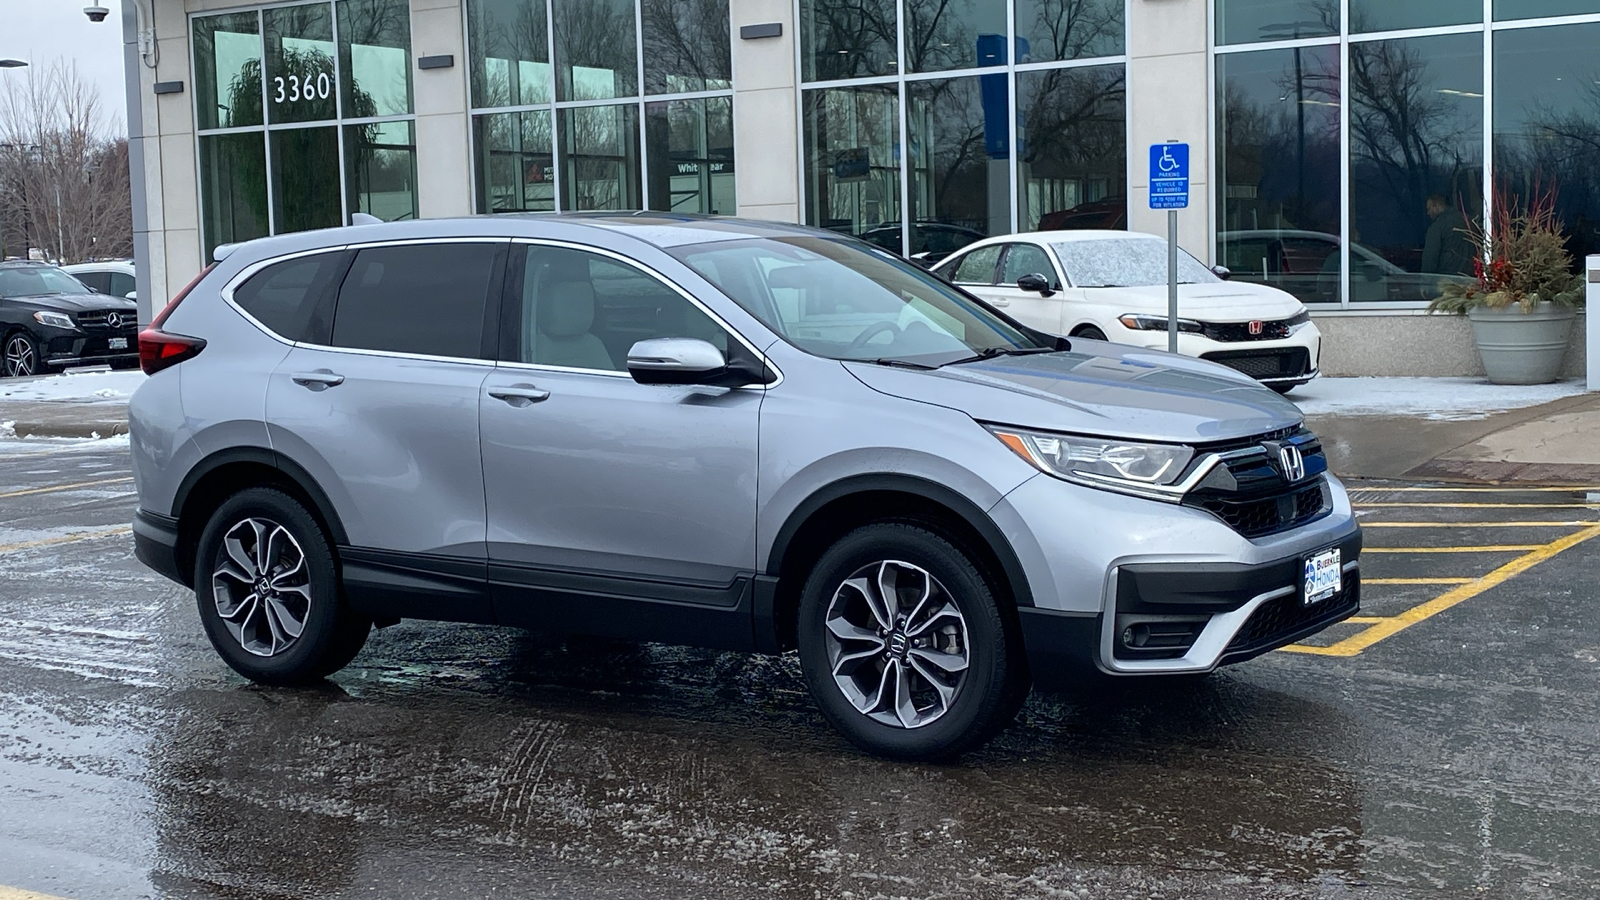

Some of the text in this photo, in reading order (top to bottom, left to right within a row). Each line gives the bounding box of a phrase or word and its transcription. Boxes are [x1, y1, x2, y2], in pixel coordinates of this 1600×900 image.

[274, 72, 330, 103] 3360
[677, 162, 699, 173] Whit
[1316, 567, 1340, 588] HONDA
